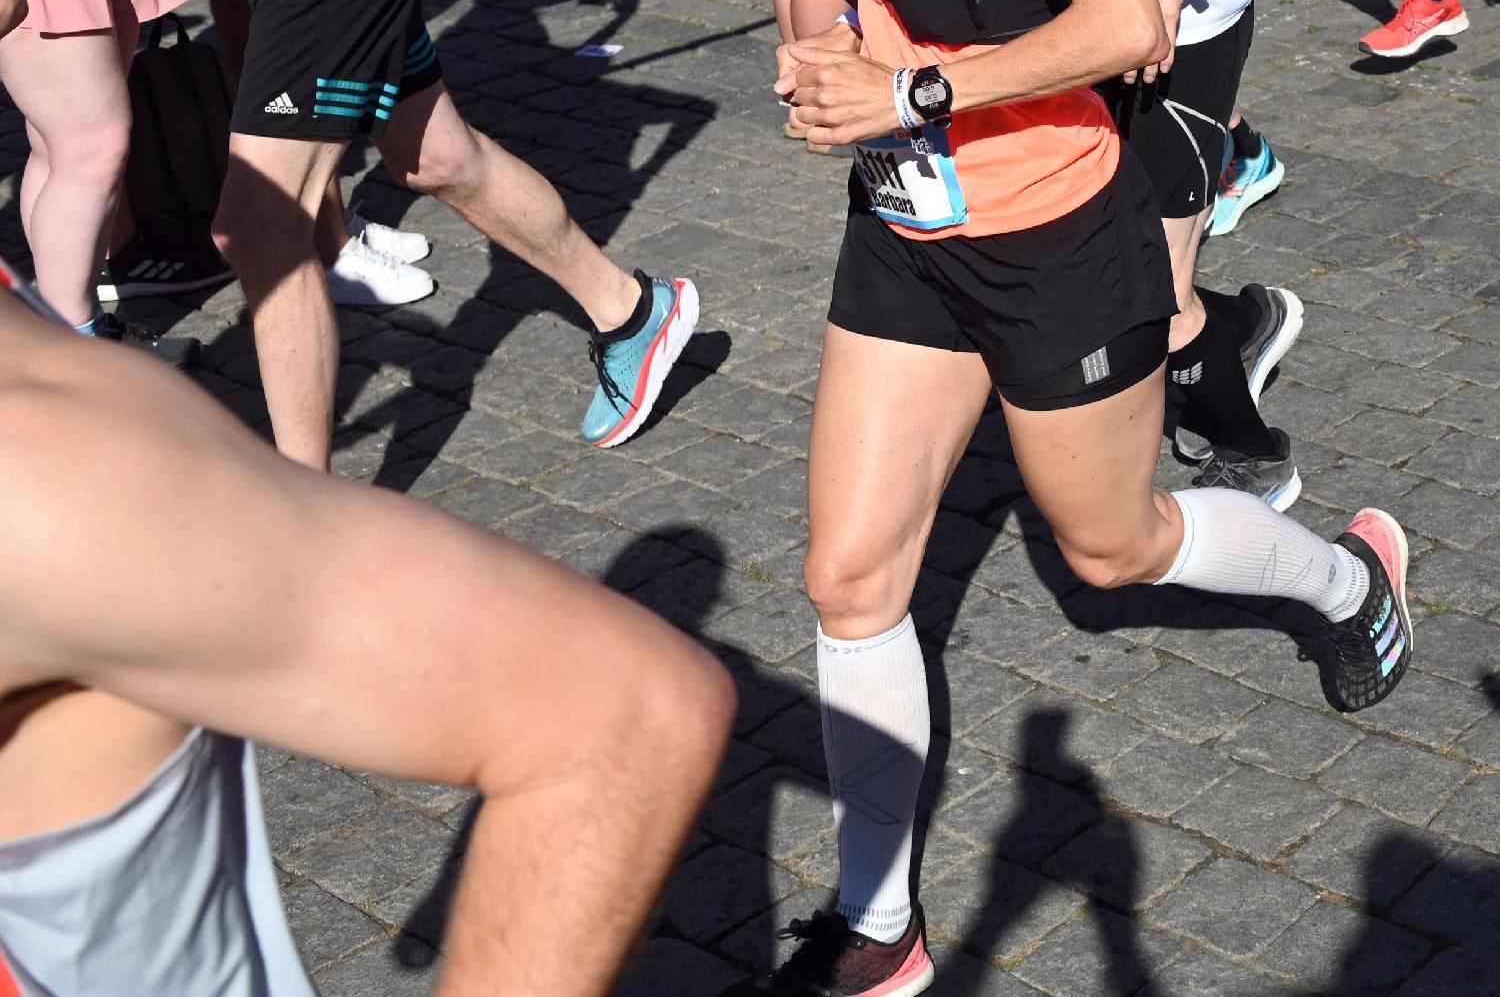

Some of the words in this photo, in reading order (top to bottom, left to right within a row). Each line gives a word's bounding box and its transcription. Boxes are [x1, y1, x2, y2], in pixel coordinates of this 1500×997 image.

[264, 105, 299, 114] adidas
[855, 146, 906, 190] 3111
[873, 190, 917, 217] Barbara
